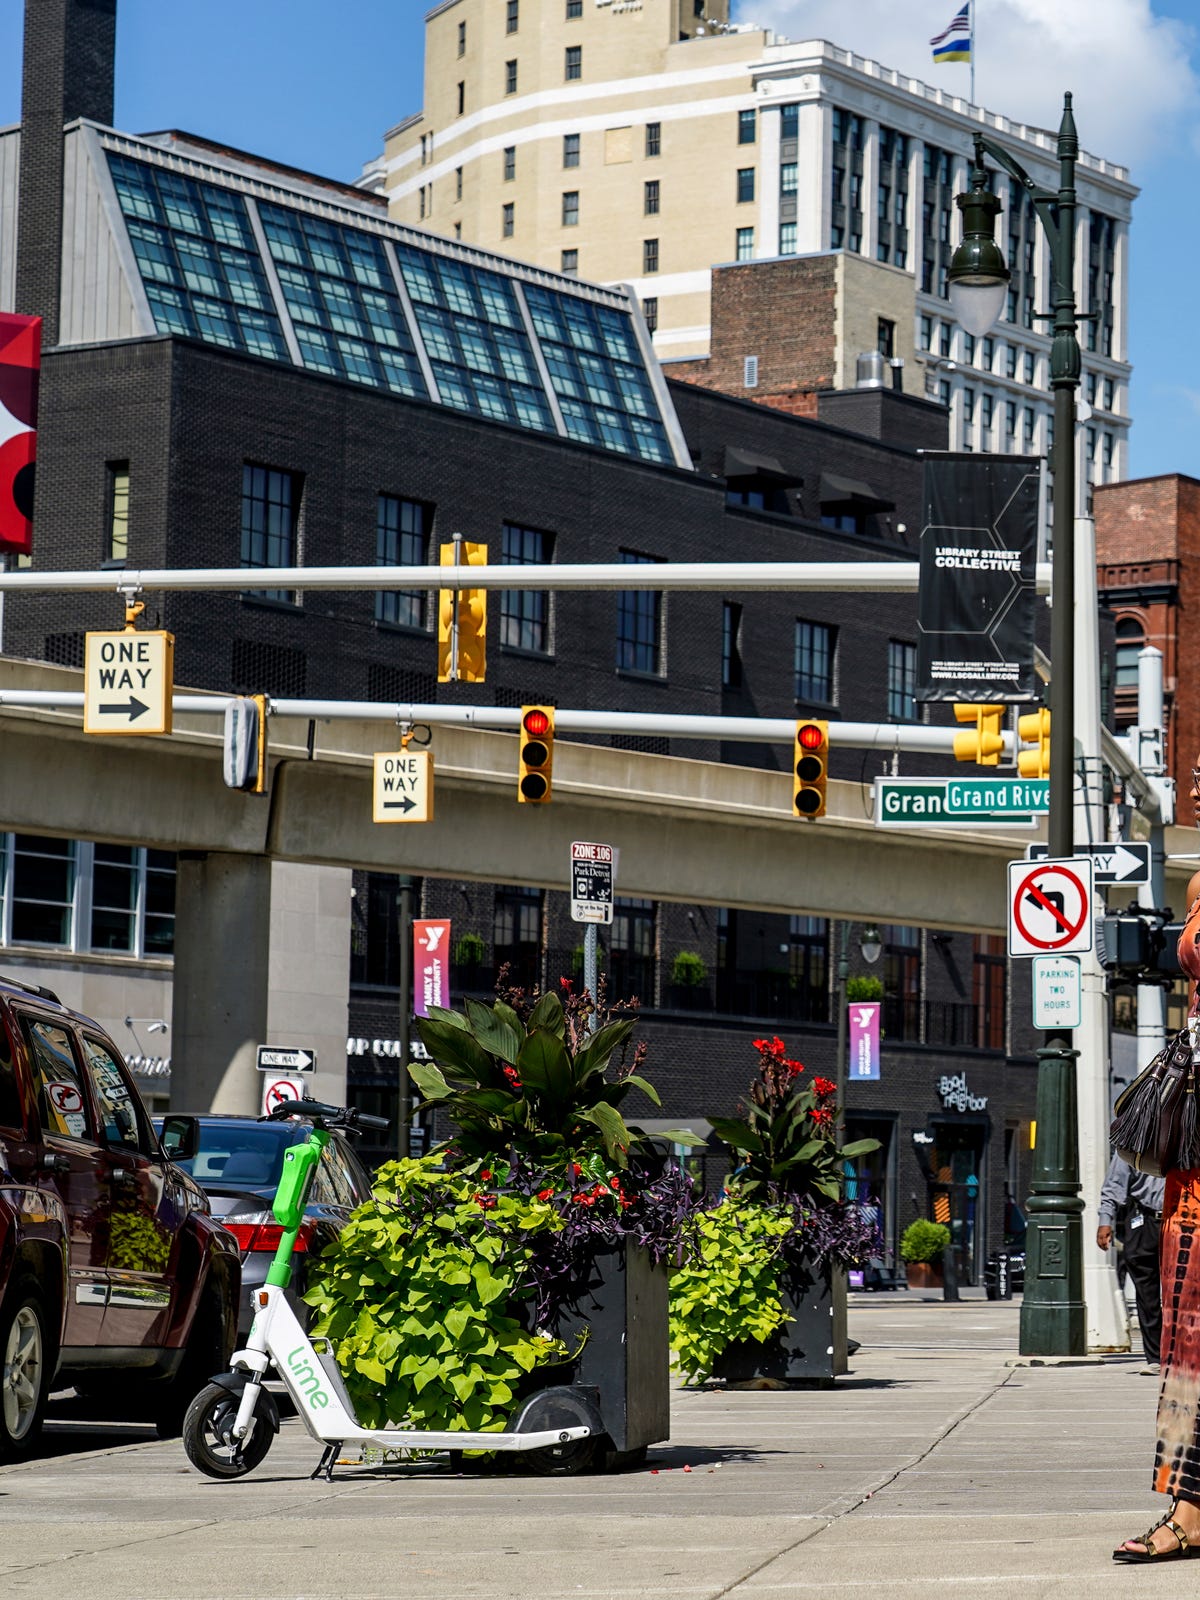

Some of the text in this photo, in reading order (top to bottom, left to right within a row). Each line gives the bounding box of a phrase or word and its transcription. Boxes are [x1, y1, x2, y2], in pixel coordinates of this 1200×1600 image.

[935, 547, 1021, 560] LIBRARY STREET
[935, 556, 1021, 571] COLLECTIVE
[101, 642, 150, 663] ONE
[99, 668, 152, 689] WAY
[931, 671, 1019, 680] WWW.LSCGALLERY.COM
[384, 759, 417, 773] ONE
[383, 777, 418, 792] WAY
[885, 792, 947, 813] Gran
[951, 786, 1050, 807] Grand Rive
[574, 844, 611, 861] ZONE 106
[1094, 856, 1112, 870] AY
[433, 958, 441, 1006] OMMUNITY
[1040, 970, 1075, 979] PARKING
[424, 976, 433, 1012] AMILY
[1049, 986, 1065, 994] TWO
[1044, 1001, 1071, 1009] HOURS
[263, 1055, 297, 1064] ONE WAY
[940, 1071, 966, 1095] good
[944, 1086, 988, 1112] neighbor
[287, 1345, 329, 1410] Lime
